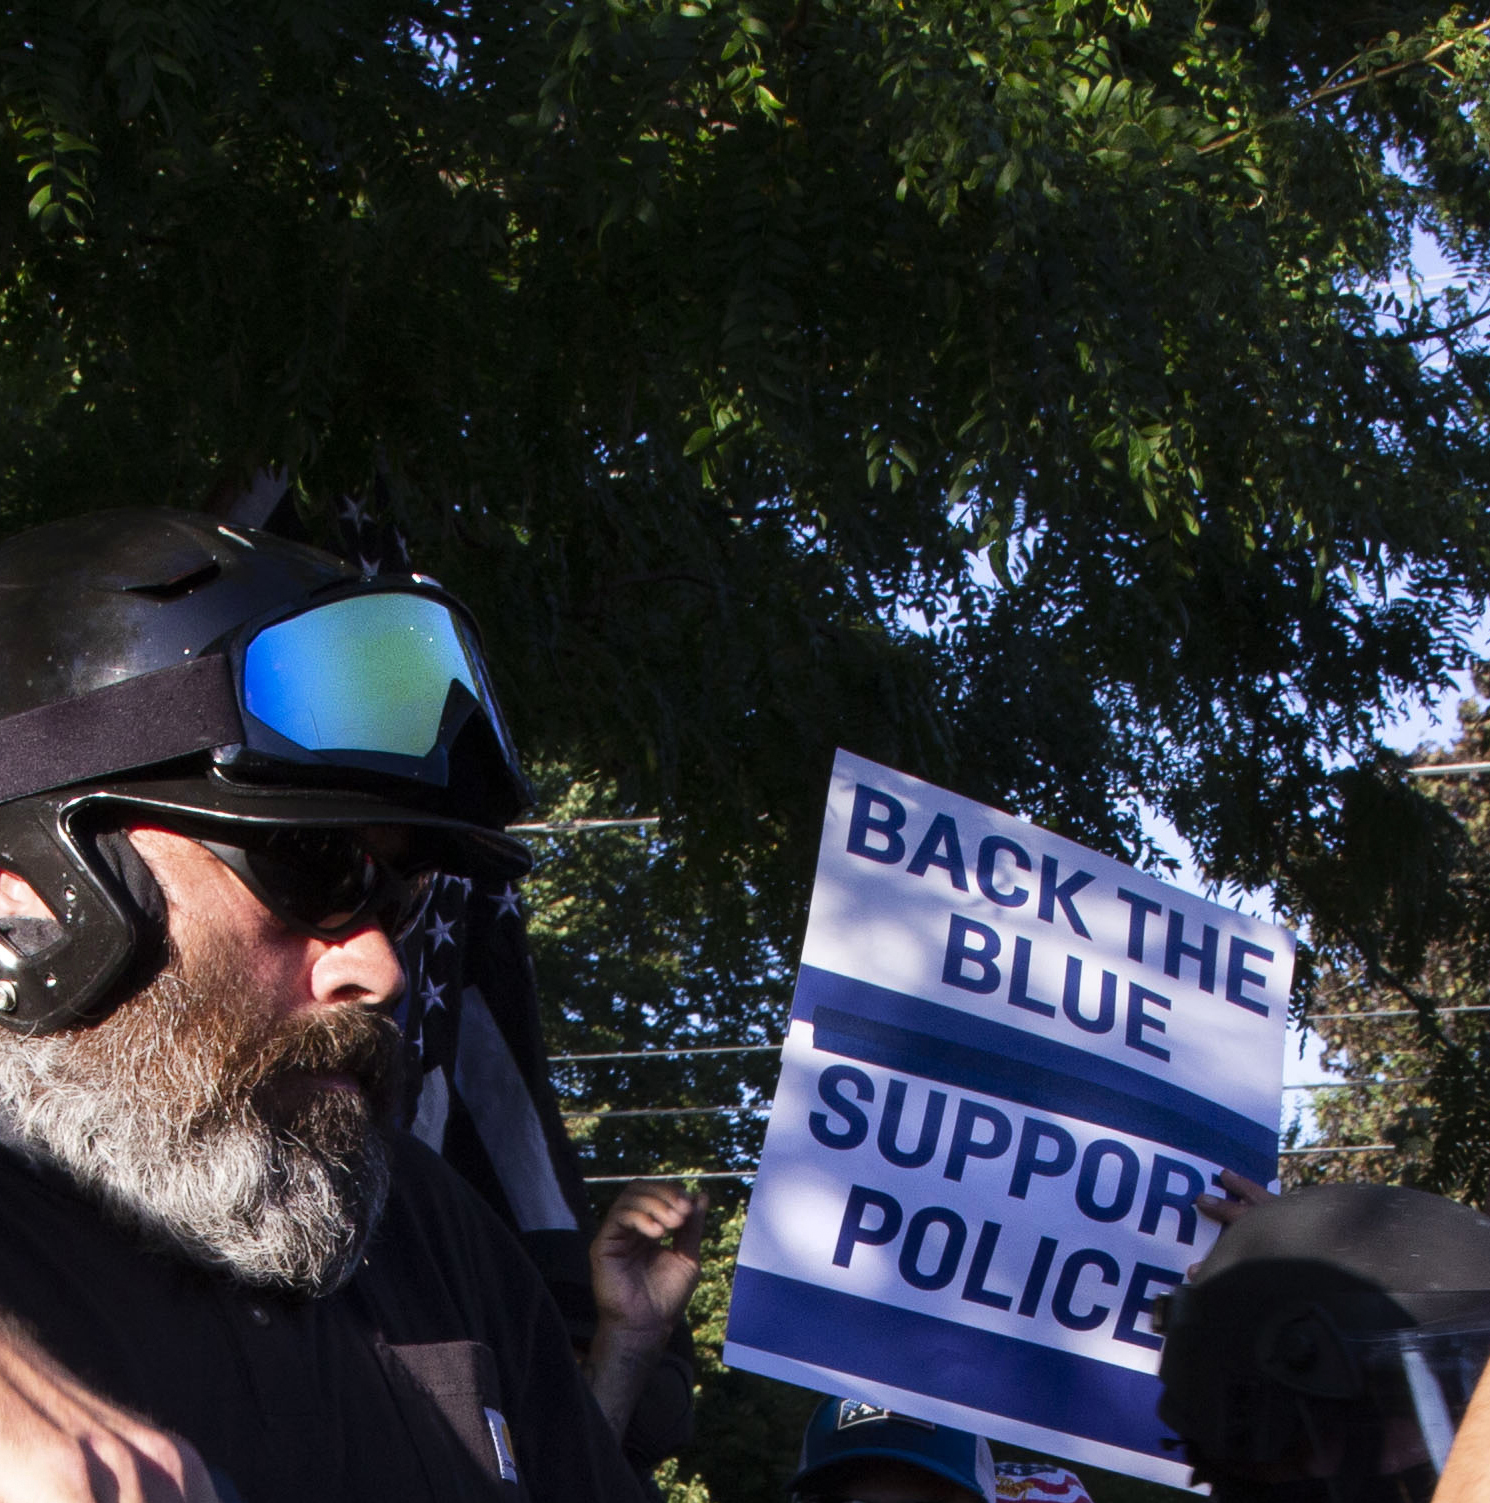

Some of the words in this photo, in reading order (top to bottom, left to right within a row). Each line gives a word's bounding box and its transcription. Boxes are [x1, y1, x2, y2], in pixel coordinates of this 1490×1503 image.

[846, 783, 1095, 941] BACK
[1117, 886, 1274, 1018] THE
[941, 913, 1172, 1062] BLUE
[832, 1184, 1185, 1351] POLICE
